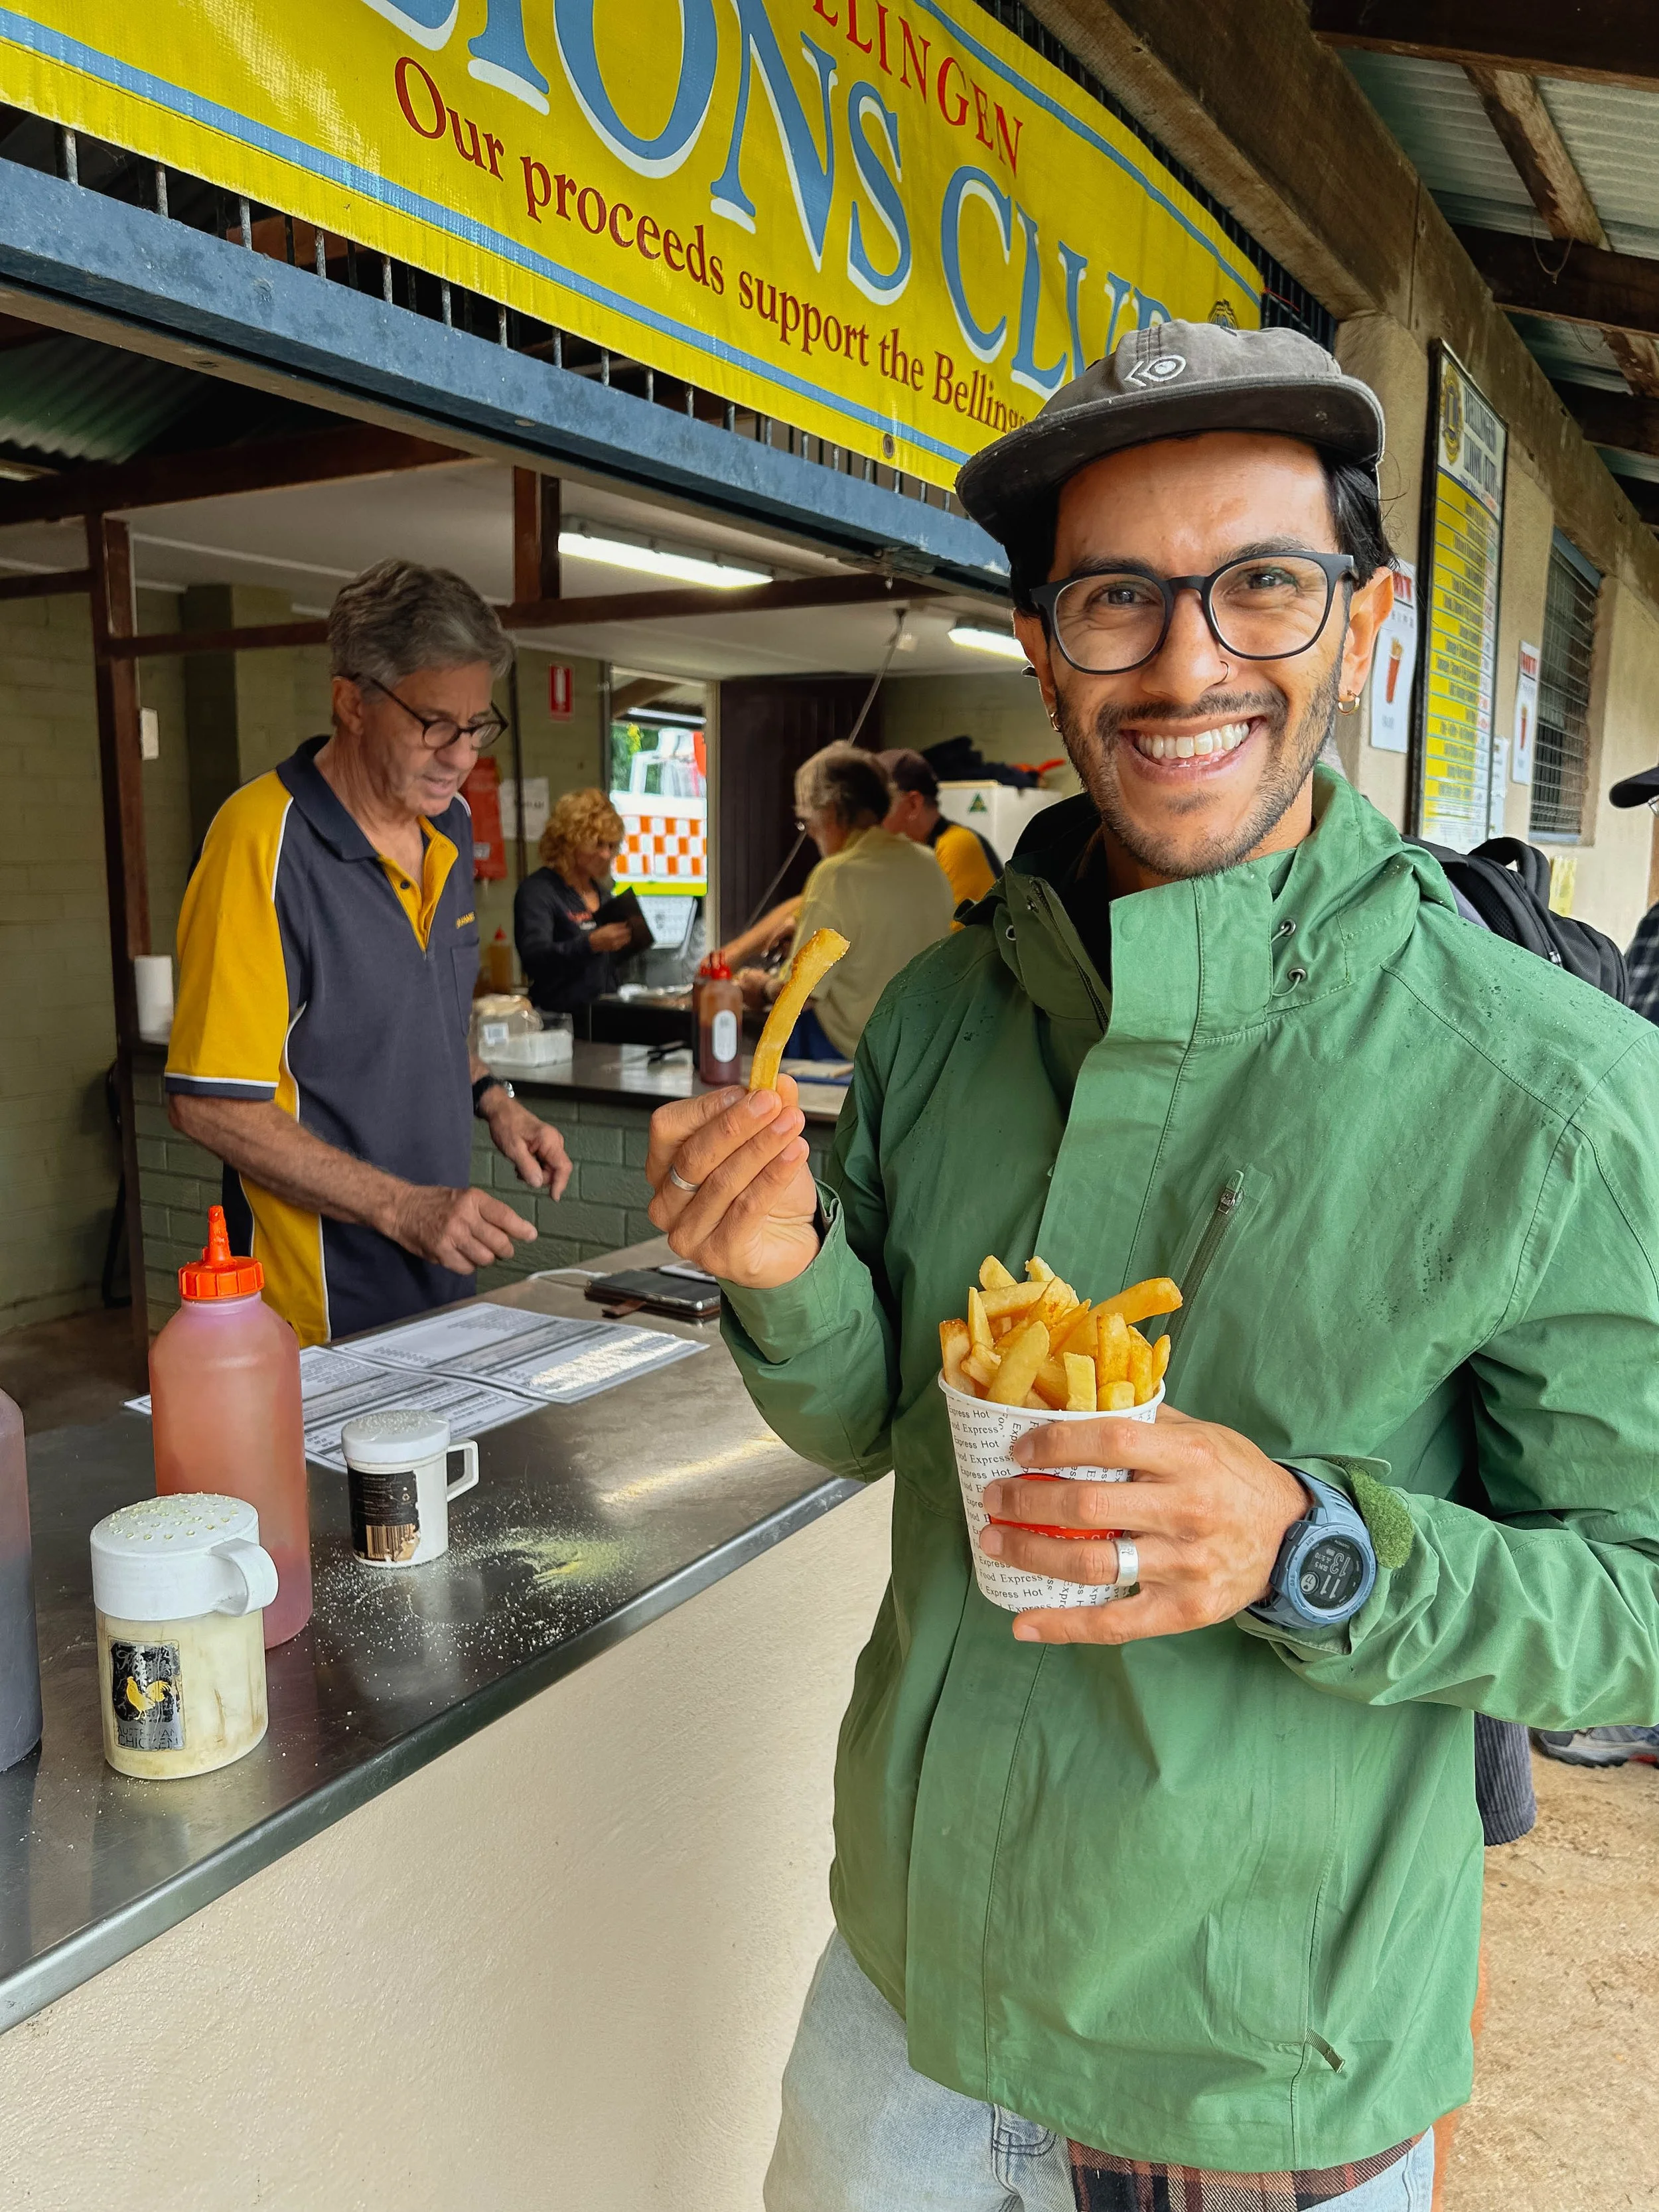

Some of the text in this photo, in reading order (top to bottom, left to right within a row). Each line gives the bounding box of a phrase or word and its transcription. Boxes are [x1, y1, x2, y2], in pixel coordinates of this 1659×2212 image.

[394, 56, 504, 182] Our
[520, 155, 725, 296] proceeds
[738, 270, 869, 366] support
[878, 327, 924, 392] the
[973, 1410, 990, 1419] Hot
[962, 1423, 999, 1436] Express
[981, 1439, 999, 1448] Hot
[970, 1453, 1011, 1466] Express
[991, 1467, 1011, 1477] Hot
[1329, 1552, 1351, 1578] 13
[1001, 1574, 1043, 1585] Express
[985, 1585, 1019, 1598] Express
[1320, 1574, 1341, 1599] 11
